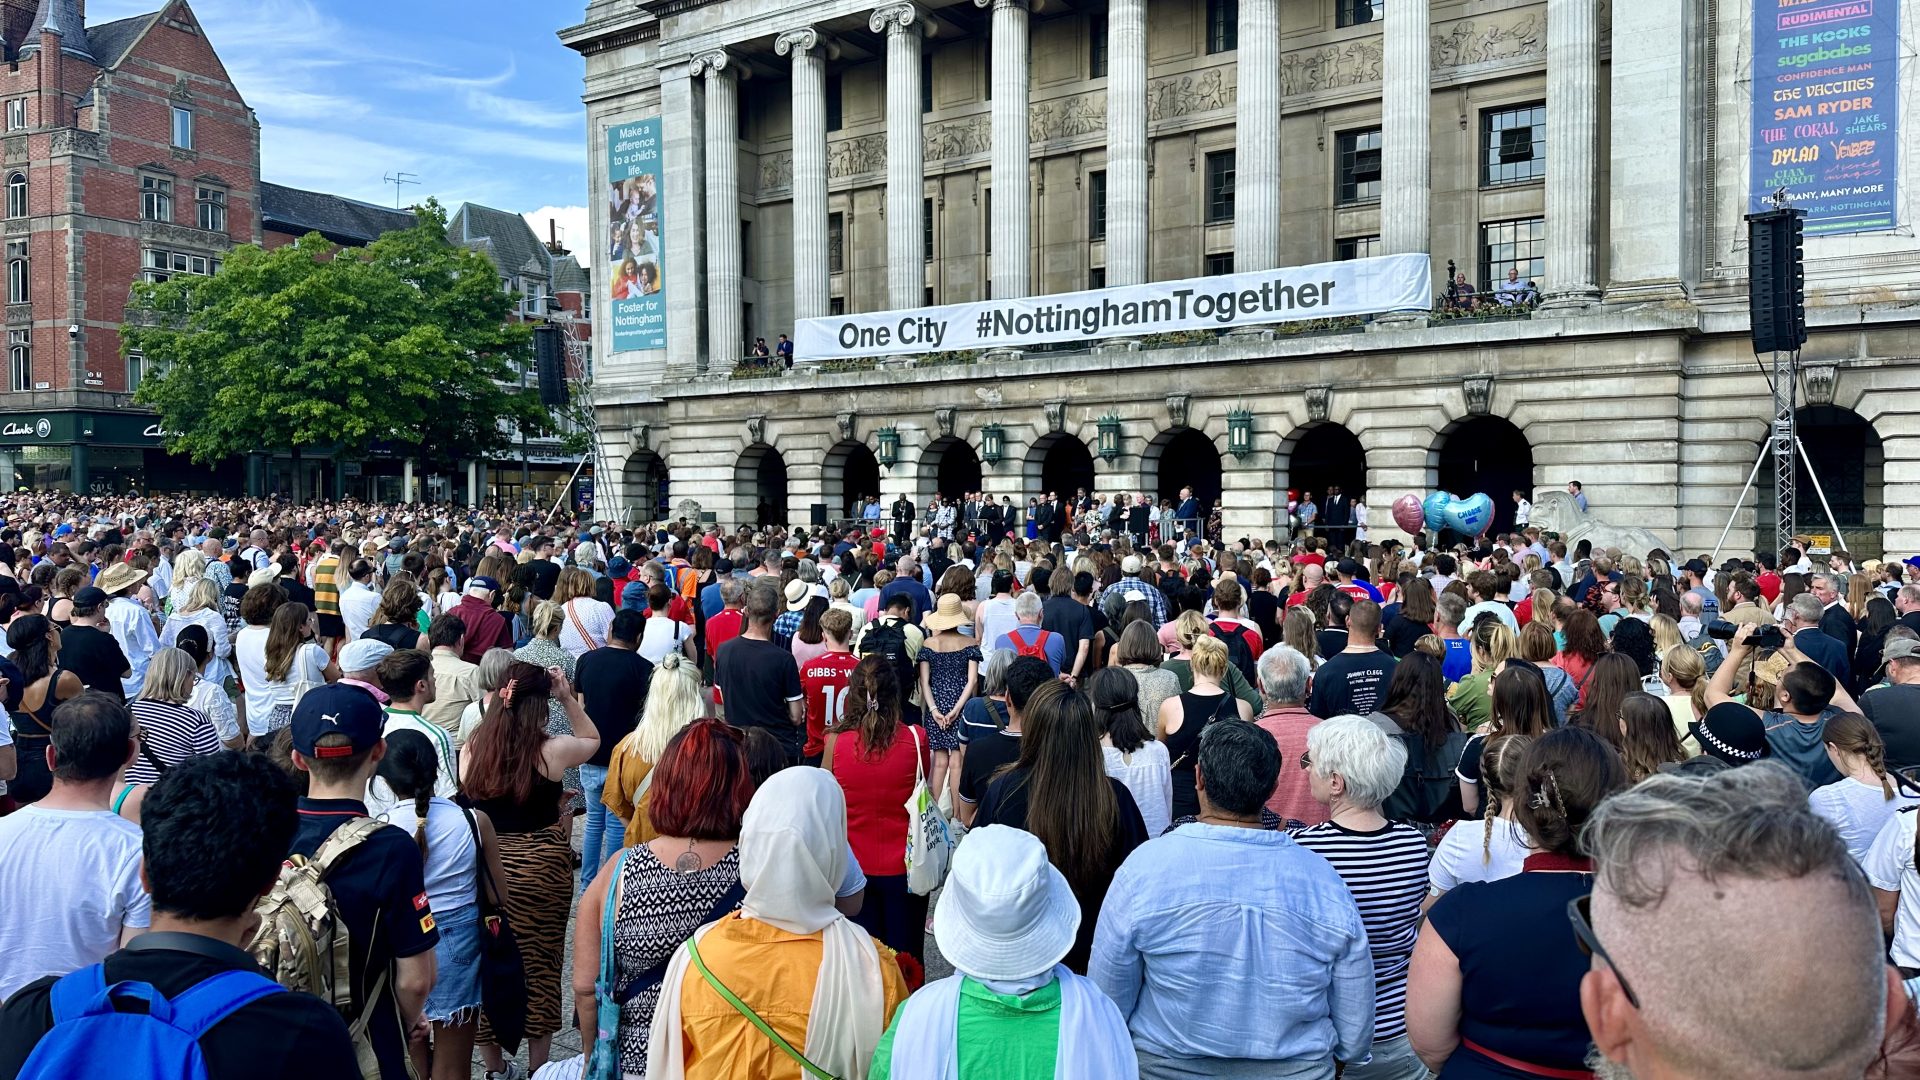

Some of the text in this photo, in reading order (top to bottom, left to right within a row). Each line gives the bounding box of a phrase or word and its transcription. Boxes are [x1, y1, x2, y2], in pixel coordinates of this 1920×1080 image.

[1782, 4, 1867, 26] RUDIMENTAL
[1779, 25, 1871, 48] THE KOOKS
[1778, 43, 1872, 67] sugababes
[1777, 62, 1872, 82] CONFIDENCE MAN
[1805, 77, 1875, 98] VACCINES
[1774, 97, 1873, 121] SAM RYDER
[1853, 114, 1880, 125] JAKE
[619, 126, 649, 139] Make a
[1760, 121, 1838, 144] THE CORAL
[1845, 122, 1888, 135] SHEARS
[614, 138, 655, 153] difference
[614, 149, 657, 166] to a child's
[1771, 144, 1819, 166] DYLAN
[628, 165, 642, 176] life.
[1774, 167, 1805, 179] CIAN
[1765, 174, 1815, 188] DUCROT
[1820, 187, 1851, 198] MANY
[1853, 184, 1884, 195] MORE
[1830, 199, 1891, 211] NOTTINGHAM
[618, 300, 658, 313] Foster for
[615, 313, 662, 327] Nottingham
[838, 280, 1336, 349] One City #NottinghamTogether
[2, 422, 34, 436] Clarks
[807, 667, 837, 678] GIBBS
